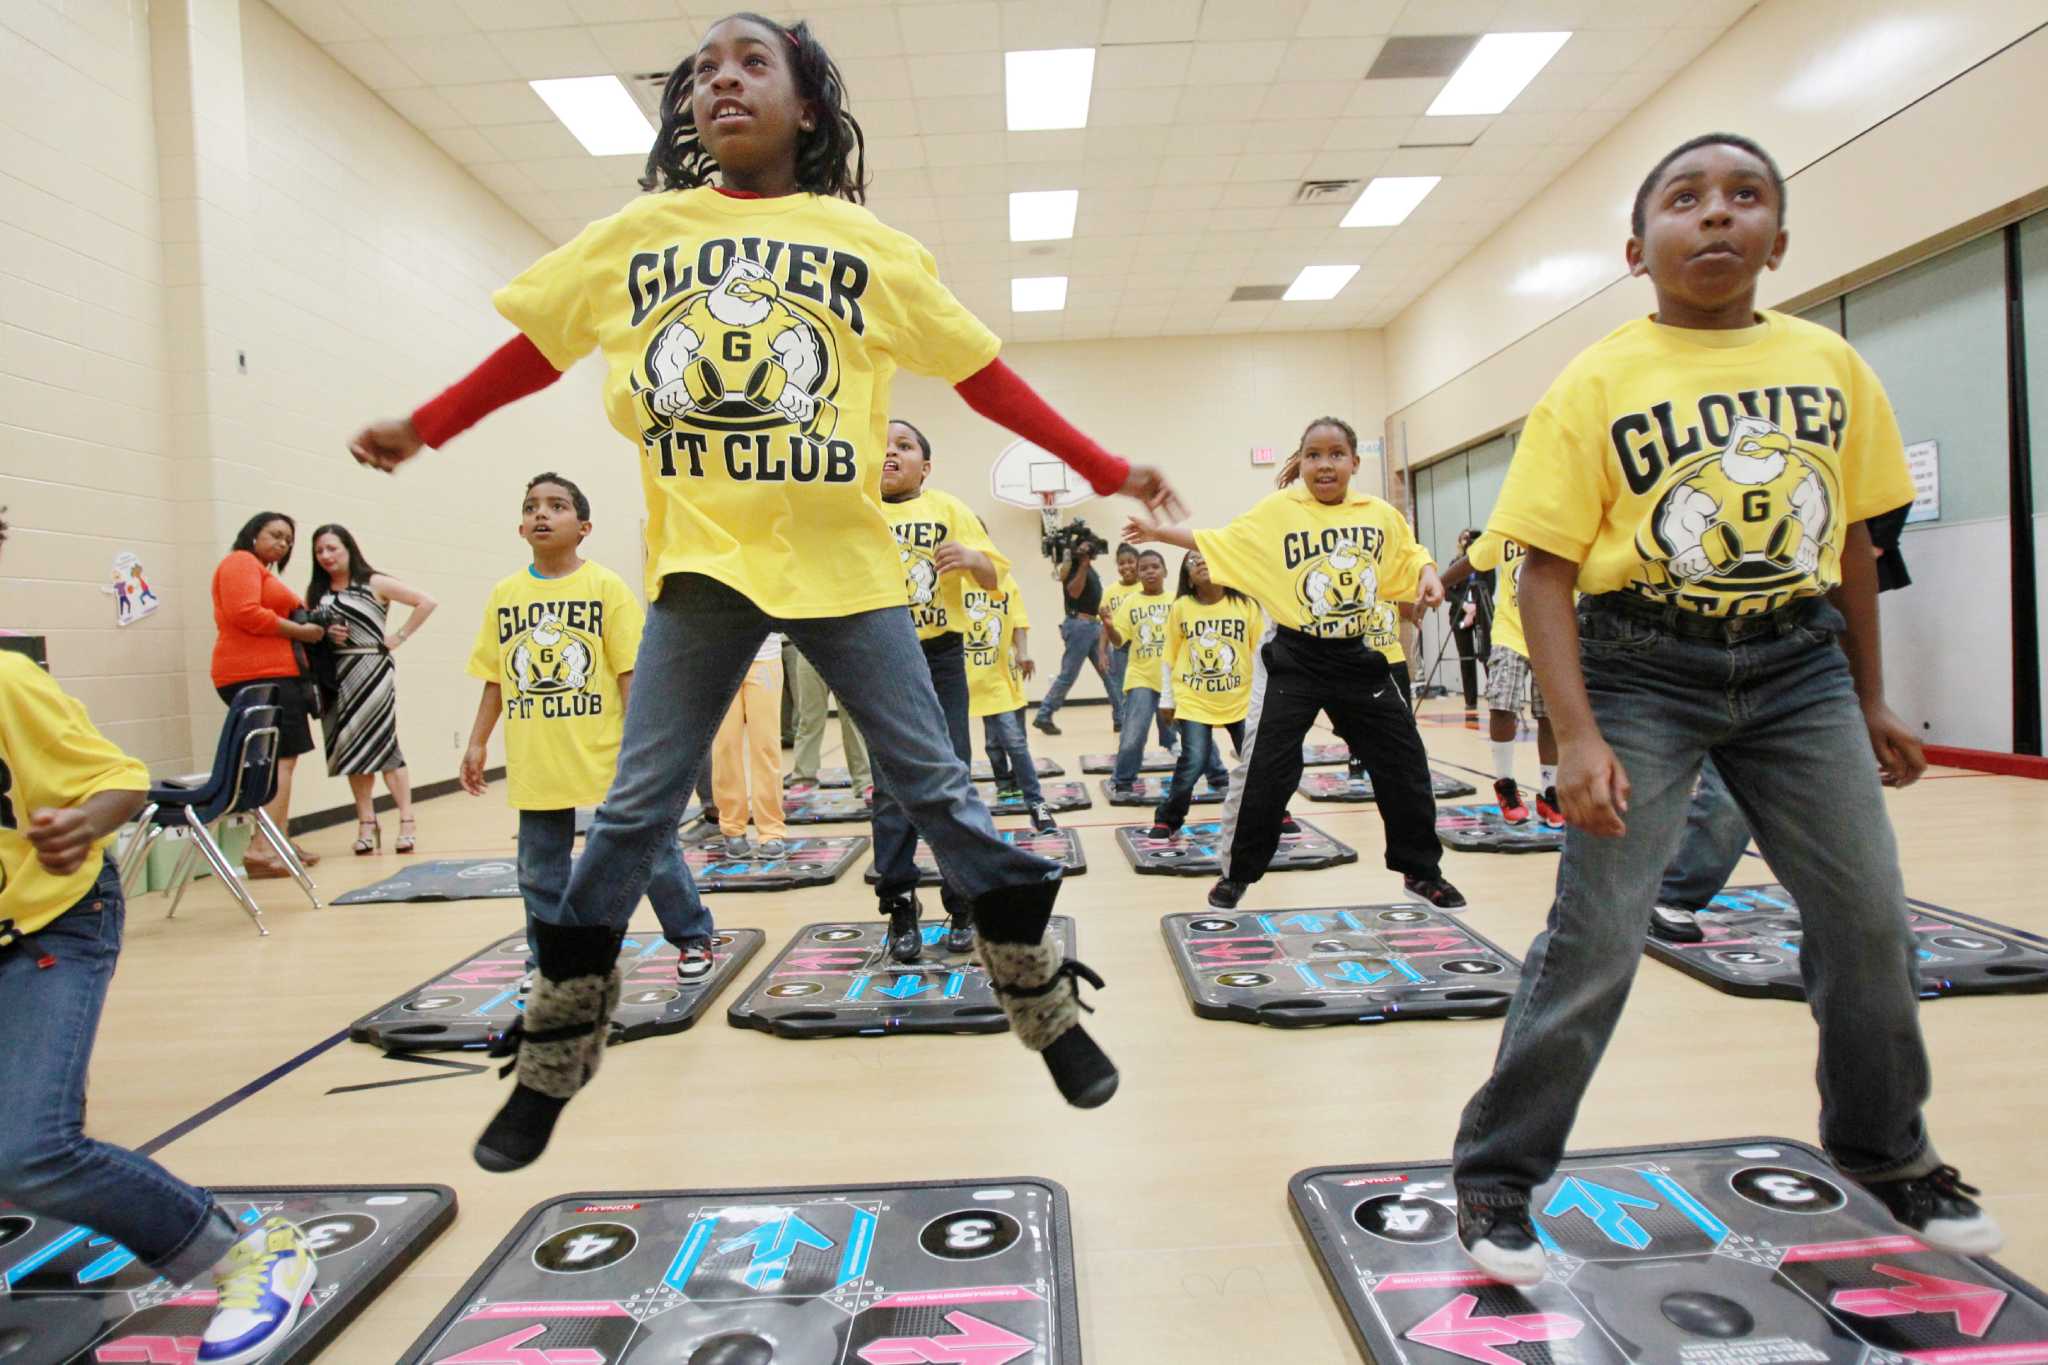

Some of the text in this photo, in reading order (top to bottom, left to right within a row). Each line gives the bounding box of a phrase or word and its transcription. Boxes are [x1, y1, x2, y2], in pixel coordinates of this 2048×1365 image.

[628, 237, 869, 336] GLOVER
[722, 331, 752, 362] G
[1611, 385, 1848, 496] GLOVER
[643, 432, 857, 483] IT CLUB
[1742, 489, 1771, 523] G
[1284, 526, 1384, 570] GLOVER
[1339, 572, 1352, 586] G
[498, 600, 604, 644] GLOVER
[910, 608, 948, 628] LUB
[1129, 604, 1172, 625] GLOV
[540, 648, 554, 663] G
[1206, 675, 1242, 692] CLUB
[507, 694, 602, 719] FIT CLUB
[1755, 1174, 1817, 1202] 3
[583, 1204, 635, 1213] KONAMI
[561, 1233, 619, 1263] 4
[947, 1219, 995, 1249] 3
